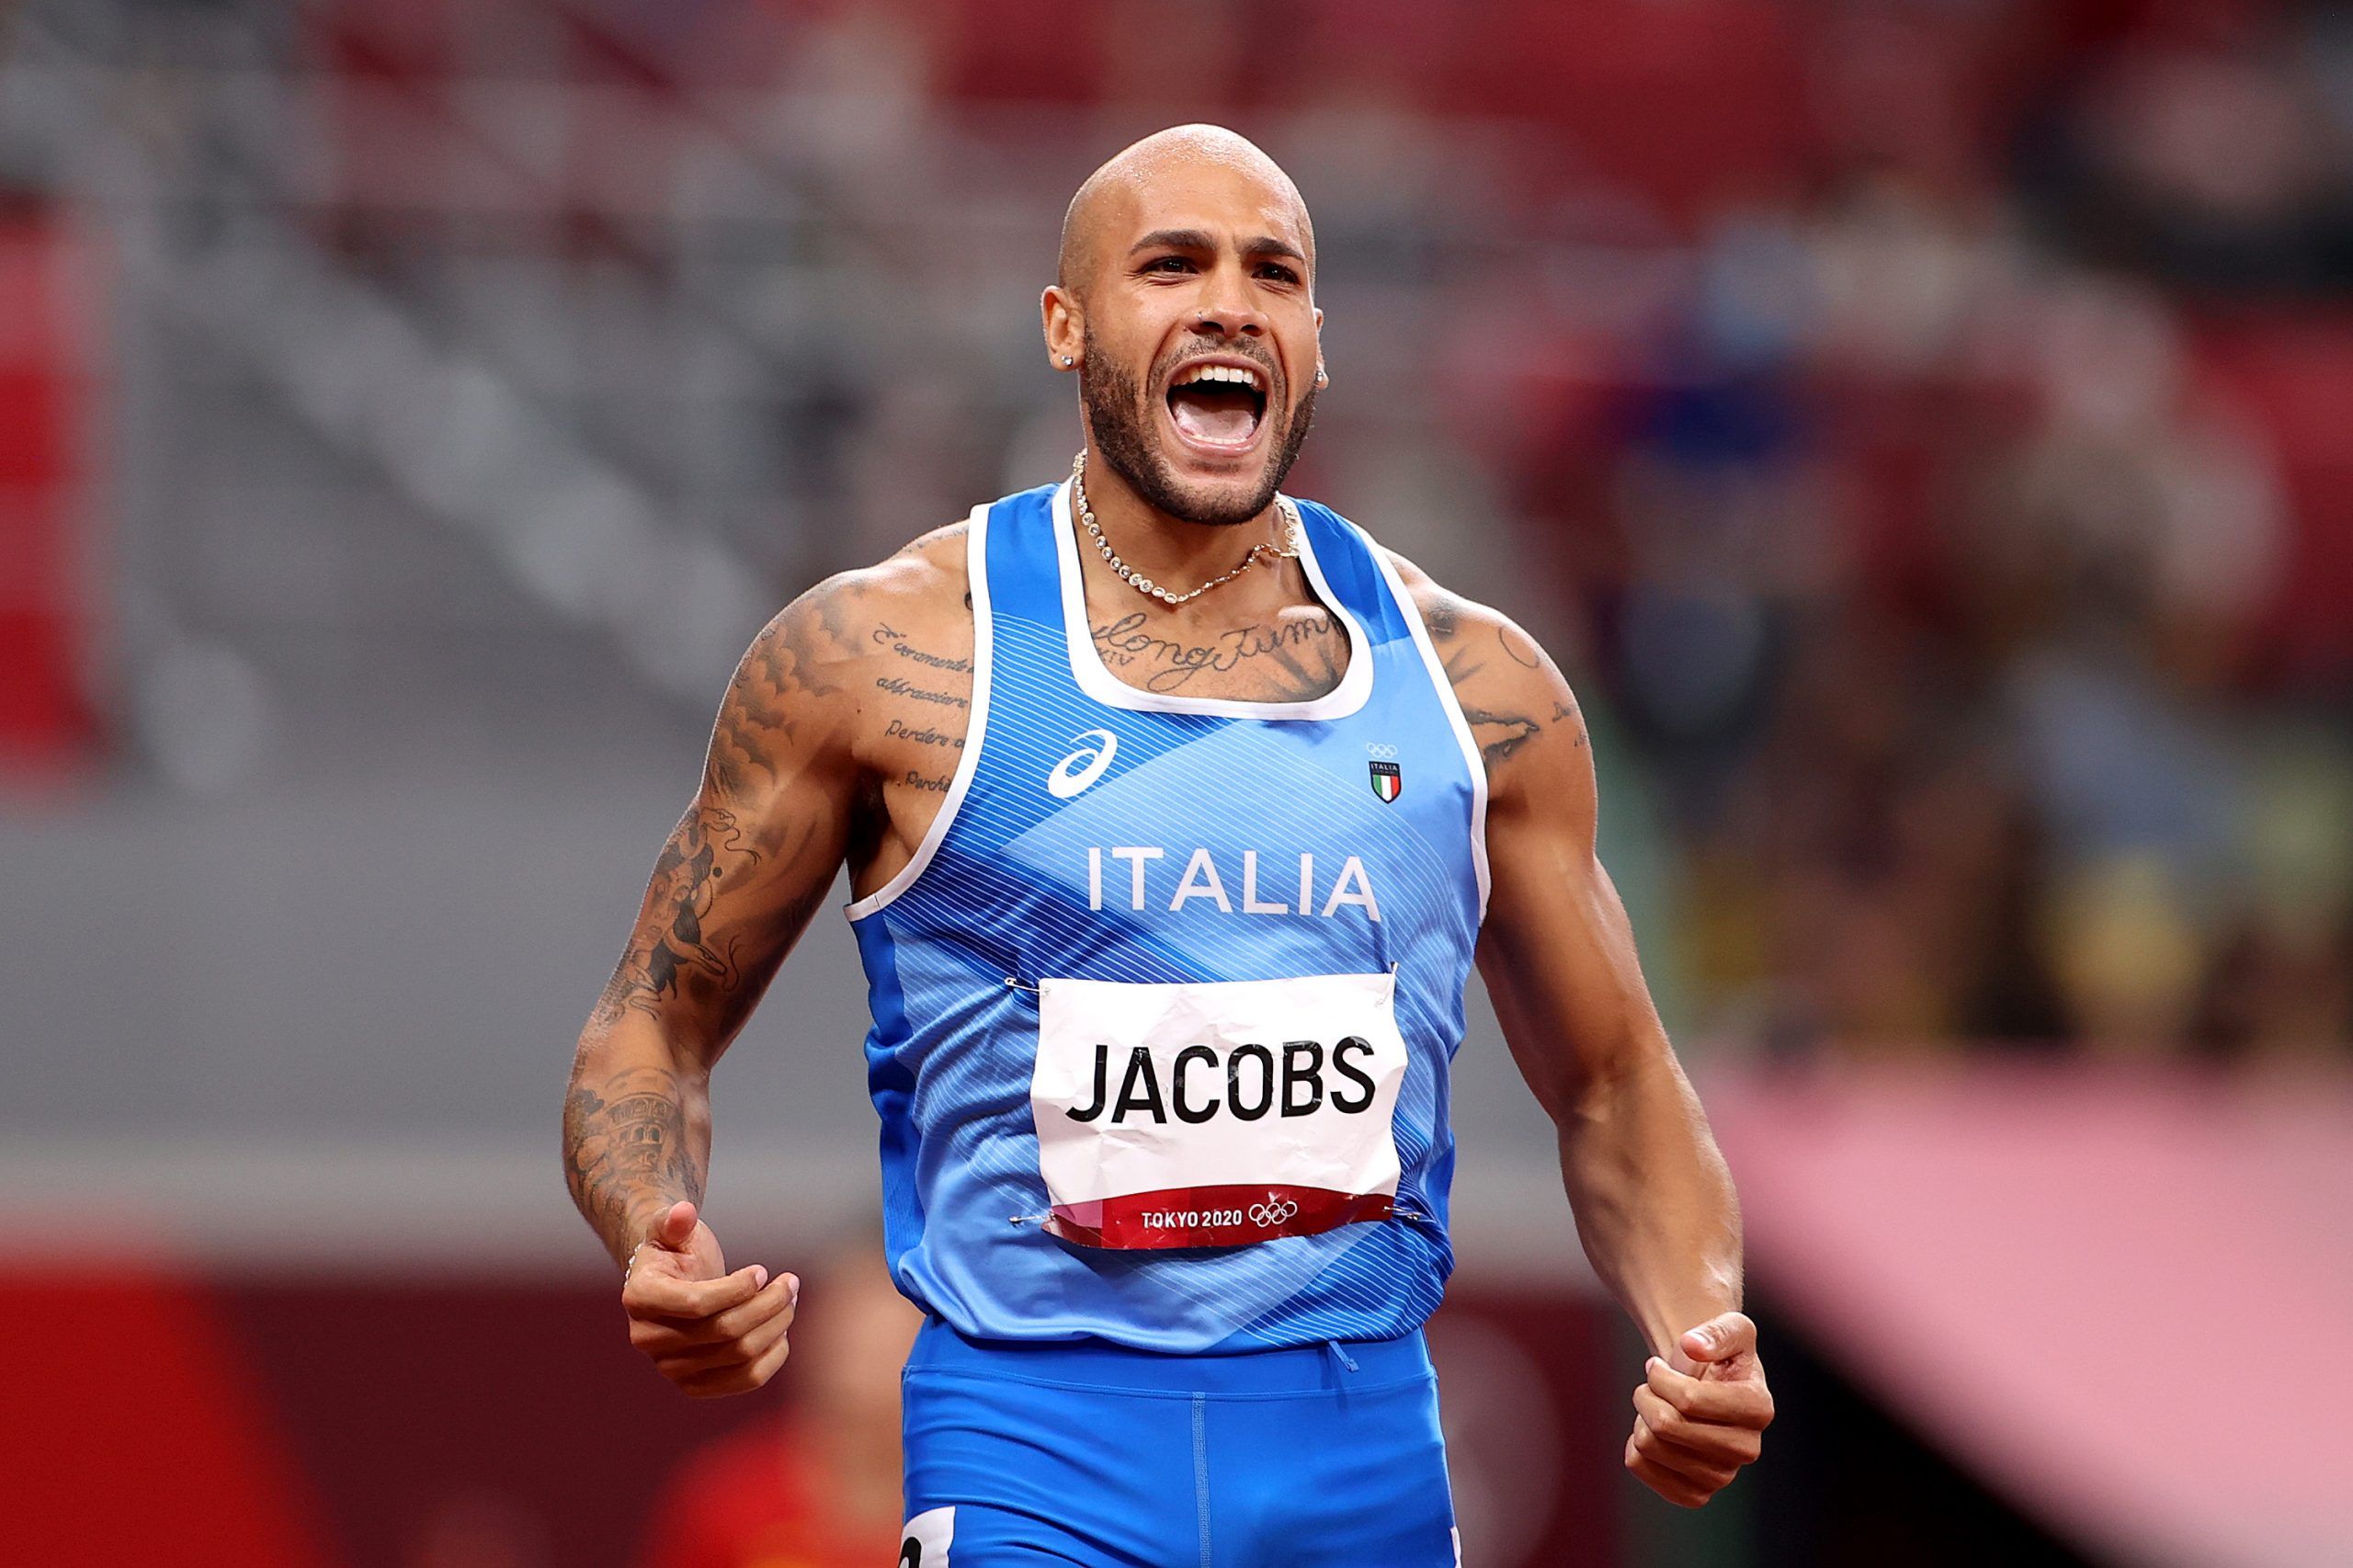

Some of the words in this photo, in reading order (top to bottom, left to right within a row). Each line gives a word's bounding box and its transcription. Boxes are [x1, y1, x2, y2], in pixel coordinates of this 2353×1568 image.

[1370, 763, 1398, 771] ITALIA
[1088, 846, 1381, 922] ITALIA
[1064, 1035, 1377, 1124] JACOBS
[1142, 1211, 1199, 1228] TOKYO
[1201, 1210, 1243, 1227] 2020
